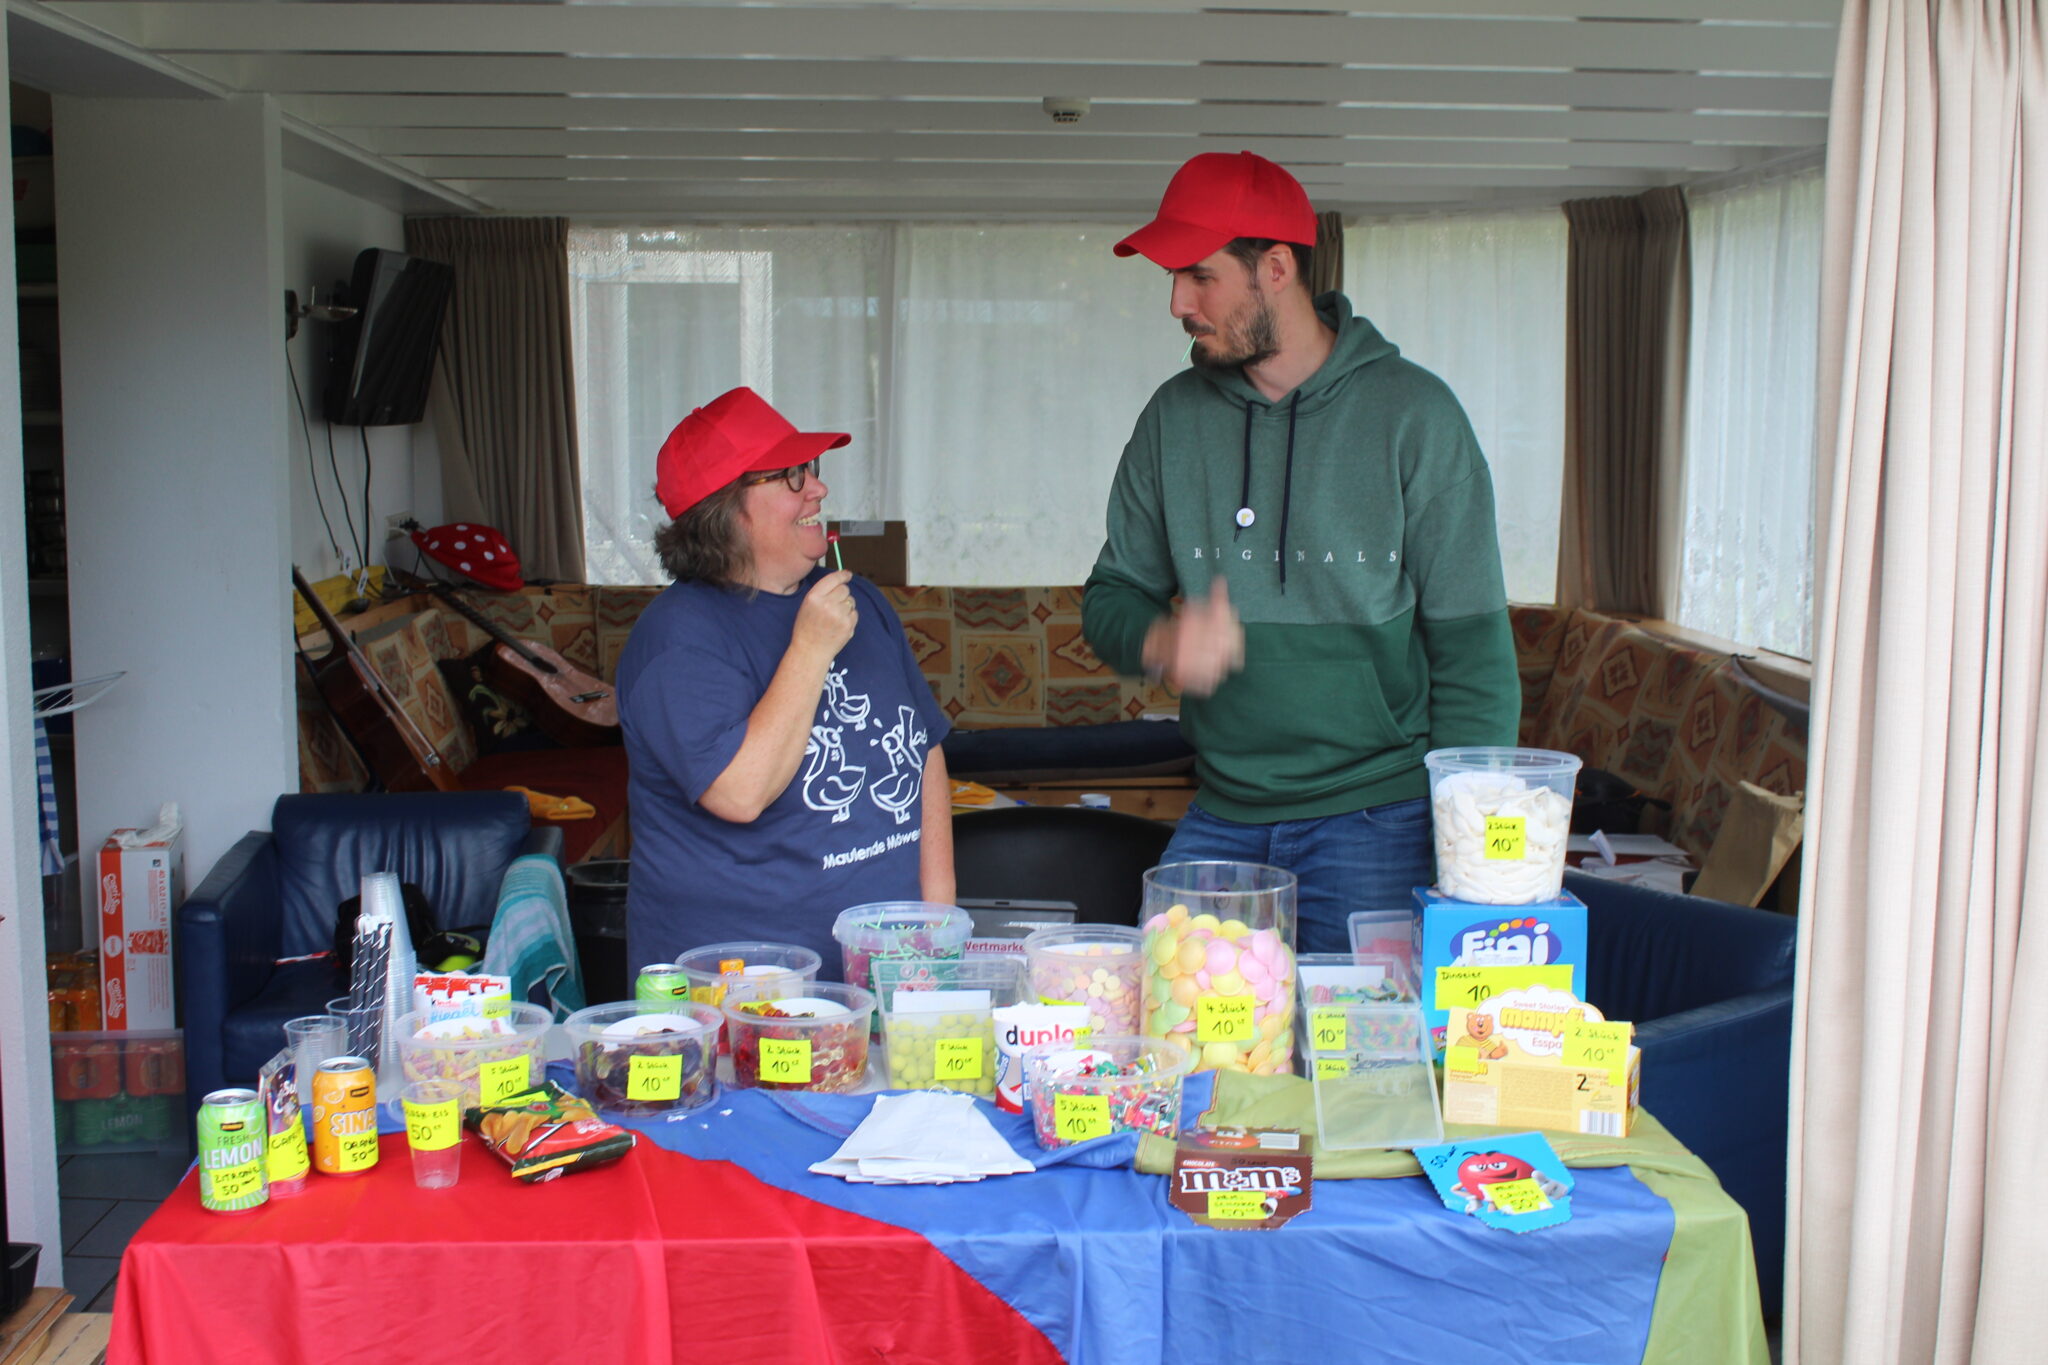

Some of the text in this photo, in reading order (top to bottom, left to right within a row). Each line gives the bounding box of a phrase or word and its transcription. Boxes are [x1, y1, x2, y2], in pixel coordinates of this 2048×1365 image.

[1487, 822, 1493, 831] 2
[822, 839, 887, 870] Maulende
[1461, 922, 1550, 966] Fini
[1467, 984, 1491, 1002] 10
[1206, 1002, 1247, 1014] 4 Stück
[1575, 1027, 1619, 1040] 2 Stück
[1576, 1073, 1590, 1091] 2
[1060, 1099, 1067, 1110] 5
[331, 1107, 377, 1137] SINA
[217, 1133, 250, 1146] FRESH
[203, 1135, 263, 1169] LEMON
[1182, 1159, 1216, 1168] CHOCOLATE
[214, 1165, 261, 1183] ZITRONE
